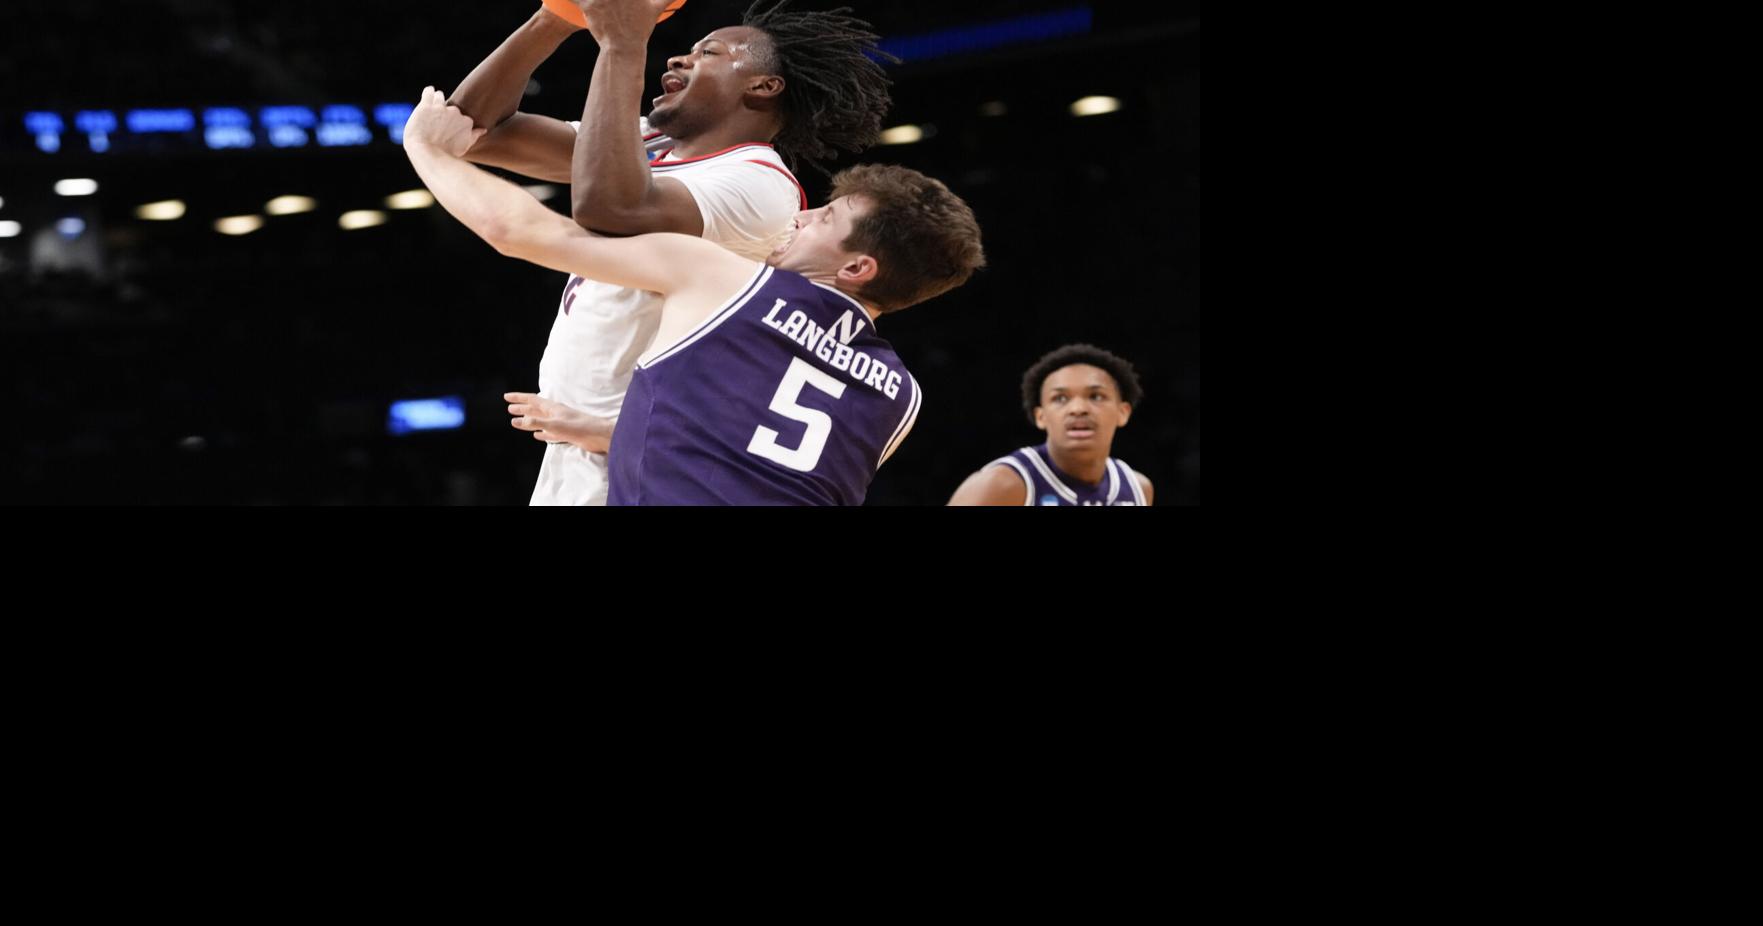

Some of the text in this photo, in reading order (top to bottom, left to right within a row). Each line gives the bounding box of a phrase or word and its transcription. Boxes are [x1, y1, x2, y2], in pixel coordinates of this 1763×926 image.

[762, 298, 902, 400] LANGBORG
[827, 310, 866, 345] N
[746, 356, 847, 472] 5
